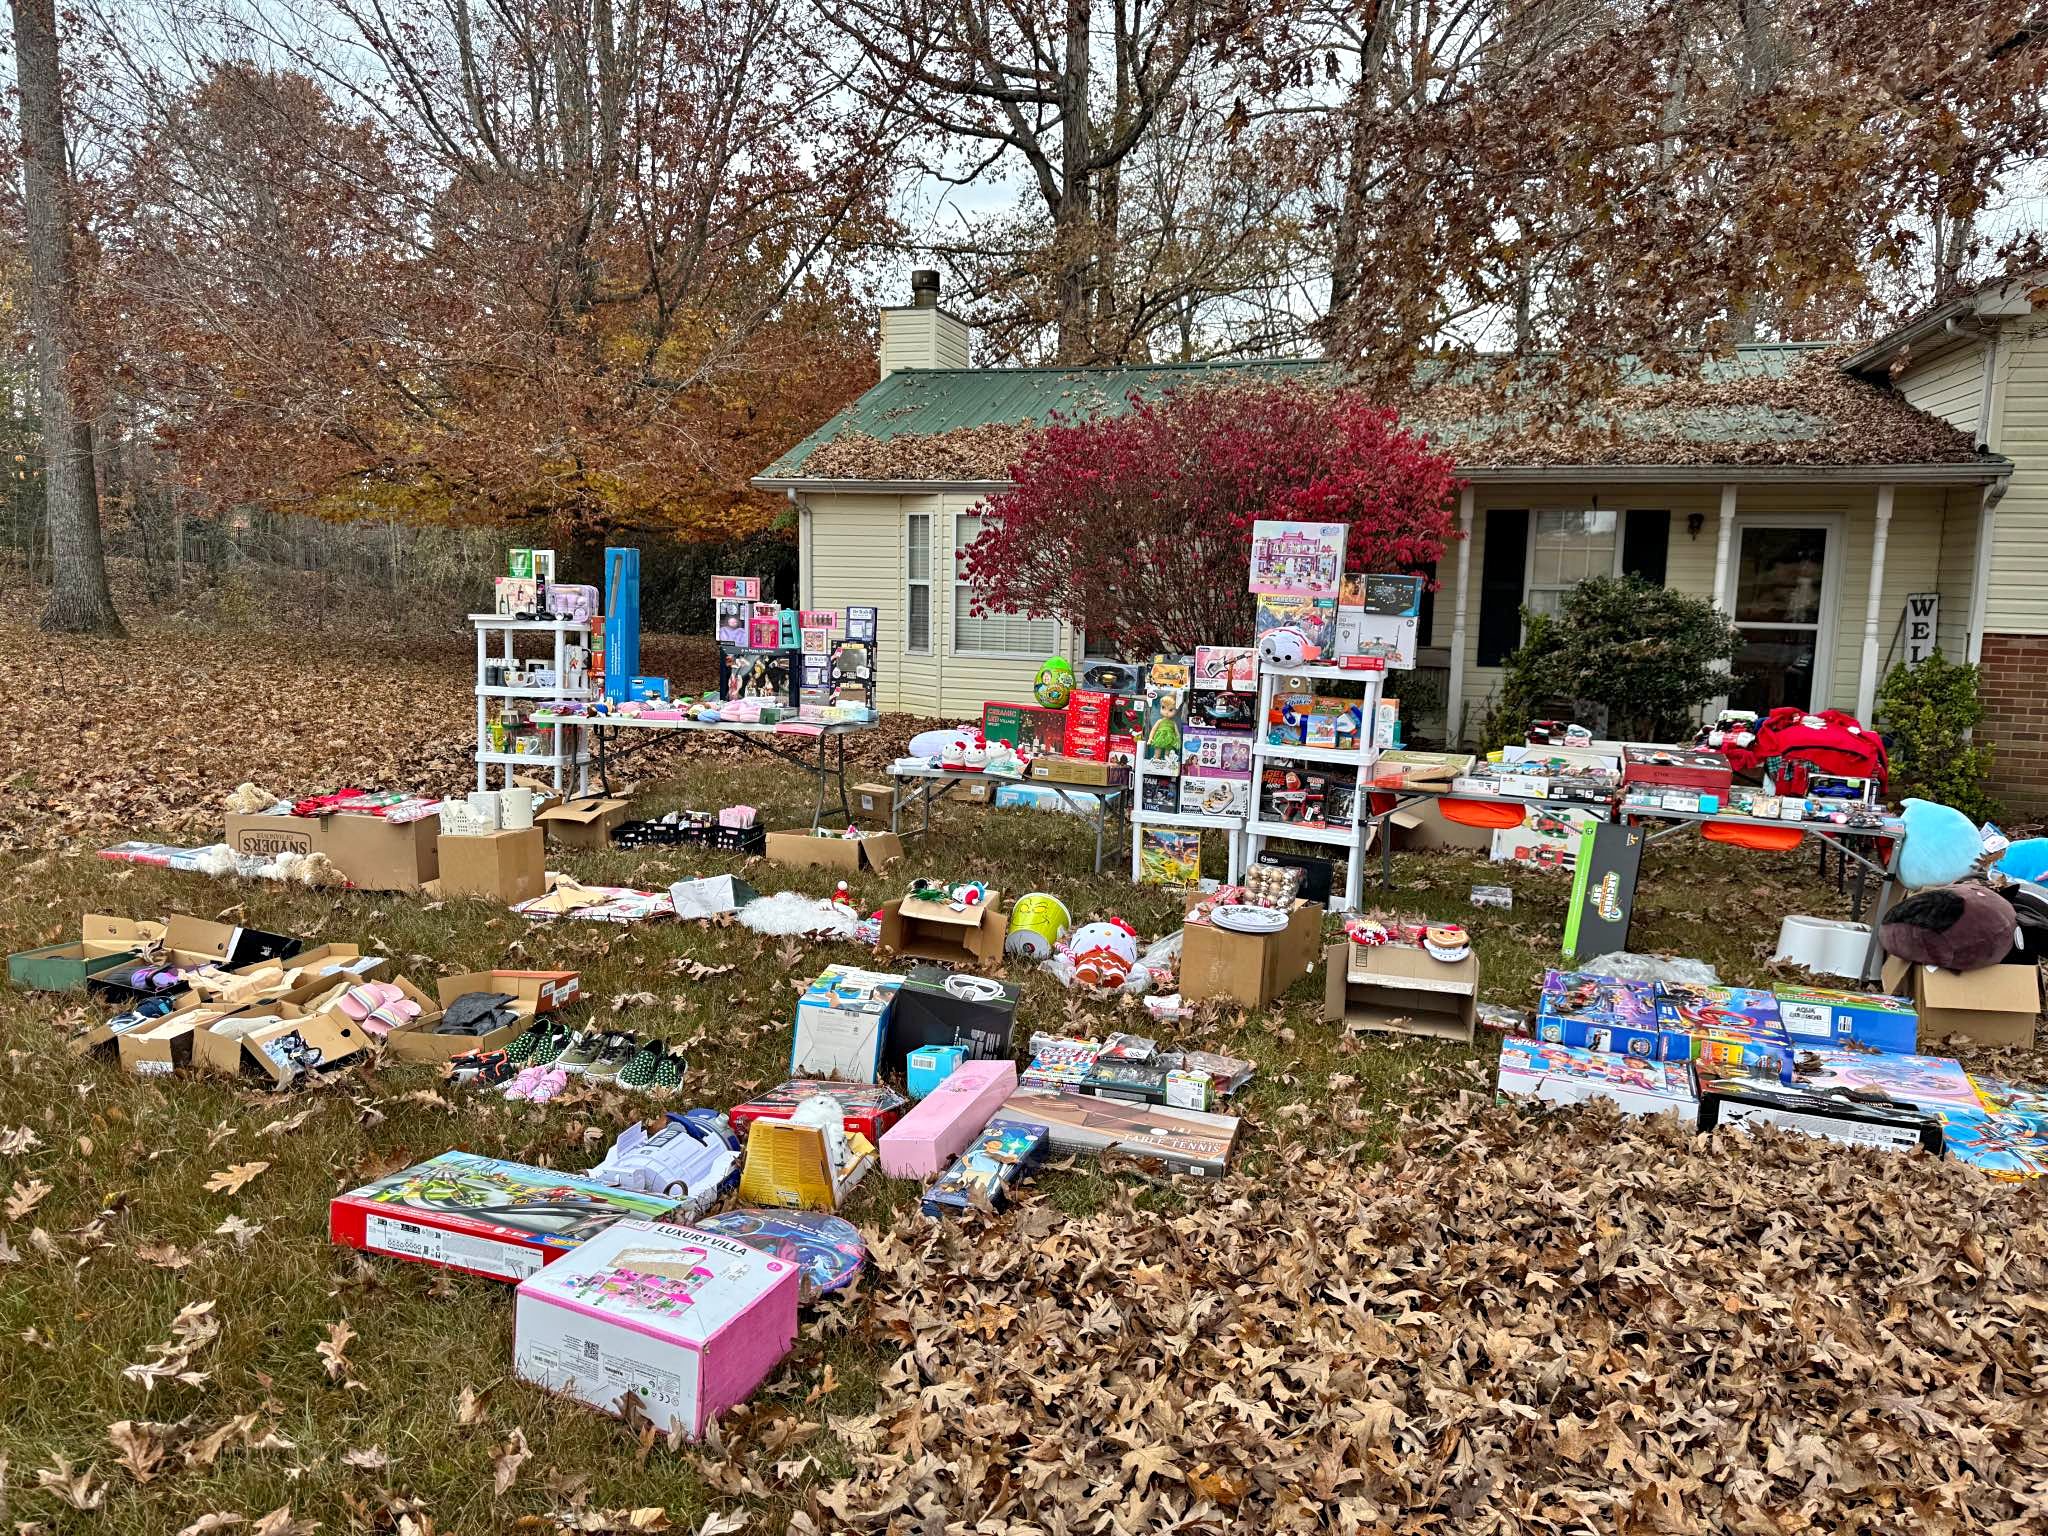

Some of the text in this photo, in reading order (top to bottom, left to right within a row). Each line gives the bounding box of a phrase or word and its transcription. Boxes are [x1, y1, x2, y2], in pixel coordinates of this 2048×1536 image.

[987, 709, 1017, 718] CERAMIC
[243, 837, 307, 855] SNYDER'S
[1592, 886, 1602, 904] SET
[1603, 872, 1617, 919] ARCHERY
[1795, 1006, 1816, 1014] AQUA
[1123, 1134, 1165, 1146] TABLE
[1171, 1140, 1222, 1153] TENNIS
[656, 1225, 712, 1243] LUXURY
[710, 1238, 749, 1256] VILLA
